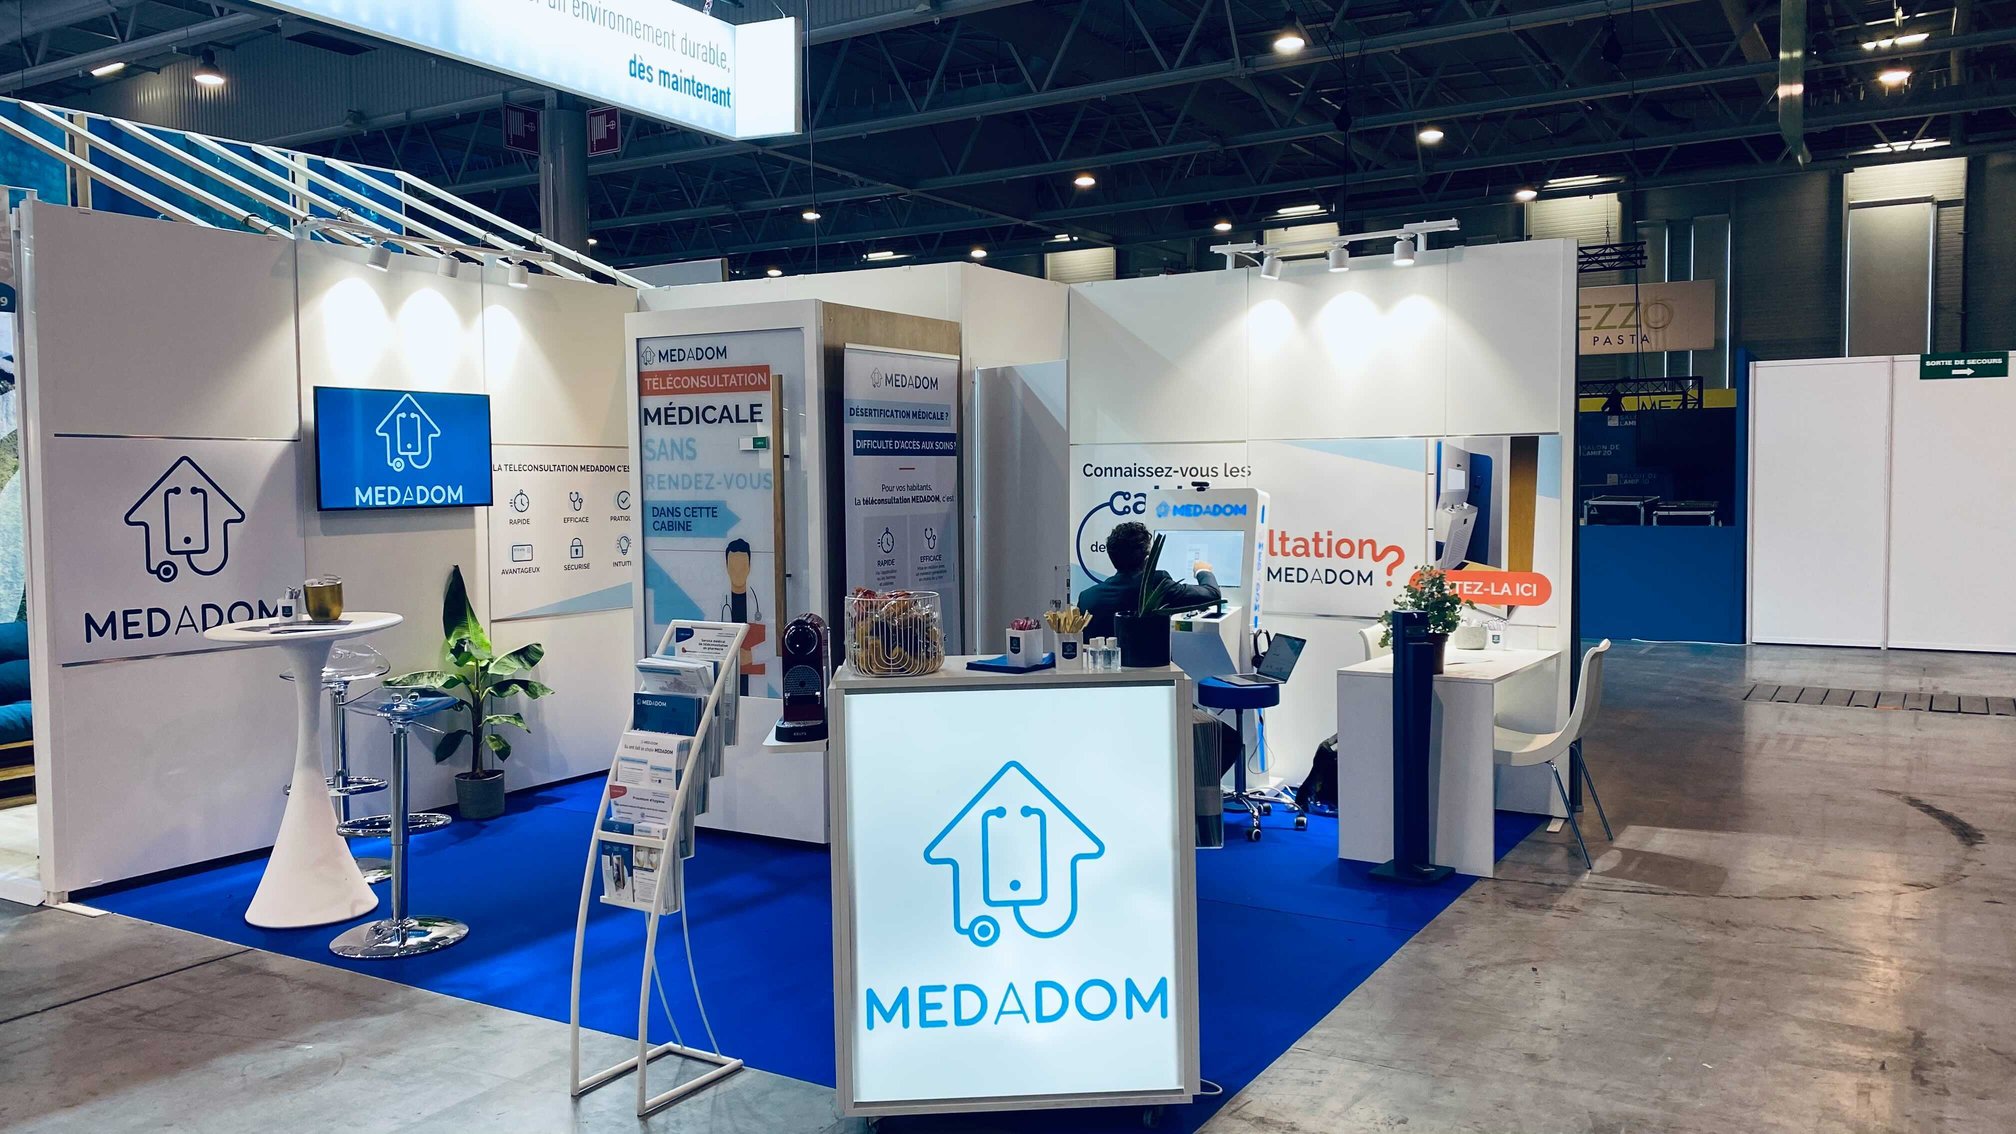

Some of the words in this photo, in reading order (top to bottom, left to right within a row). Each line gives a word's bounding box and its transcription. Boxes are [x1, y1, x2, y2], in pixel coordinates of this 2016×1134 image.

[572, 0, 676, 52] environnement
[680, 32, 730, 73] durable,
[628, 53, 654, 83] dès
[658, 69, 732, 109] maintenant
[1578, 301, 1674, 331] EZZO
[1592, 334, 1650, 347] PASTA
[658, 345, 728, 363] MEDADOM
[1966, 358, 2003, 366] SECOURS
[644, 373, 767, 391] TÉLÉCONSULTATION
[884, 373, 939, 391] MEDADOM
[644, 402, 763, 426] MÉDICALE
[849, 405, 911, 419] DÉSERTIFICATION
[911, 409, 944, 421] MÉDICALE
[644, 436, 697, 462] SANS
[921, 441, 934, 450] AUX
[492, 463, 503, 472] LA
[579, 464, 616, 473] MEDADOM
[1082, 463, 1219, 478] Connaissez-vous
[1224, 463, 1251, 478] les
[645, 472, 773, 491] RENDEZ-VOUS
[881, 484, 895, 492] Pour
[355, 485, 464, 506] MEDADOM
[862, 496, 911, 505] téléconsultation
[651, 506, 681, 518] DANS
[683, 506, 718, 518] CETTE
[1172, 503, 1248, 518] MEDADOM
[563, 516, 589, 524] EFFICACE
[652, 520, 693, 532] CABINE
[877, 558, 896, 567] RAPIDE
[920, 554, 943, 563] EFFICACE
[501, 567, 541, 575] AVANTAGEUX
[1266, 566, 1374, 587] MEDADOM
[1515, 583, 1537, 597] ICI
[865, 976, 1169, 1031] MEDADOM
